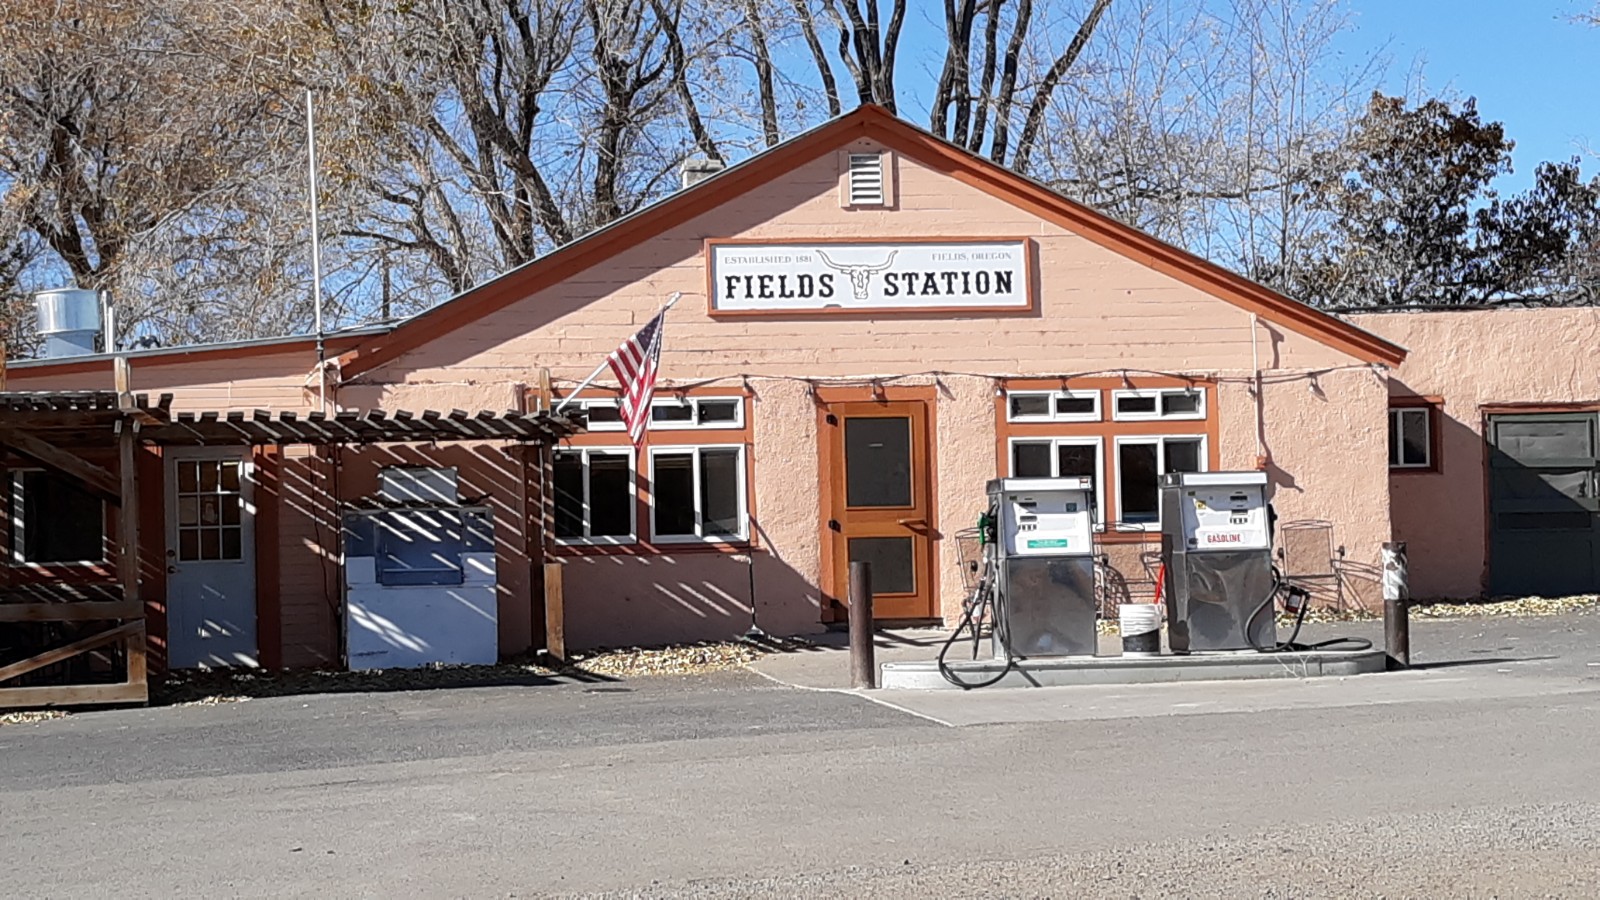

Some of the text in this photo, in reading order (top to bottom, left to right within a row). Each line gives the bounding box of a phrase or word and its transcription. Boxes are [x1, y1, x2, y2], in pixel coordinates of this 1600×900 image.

[724, 255, 813, 265] ESTABLISHED 1881
[971, 251, 1012, 261] OREGON
[724, 270, 1014, 300] FIELDS STATION
[1207, 533, 1242, 544] GASOLINE
